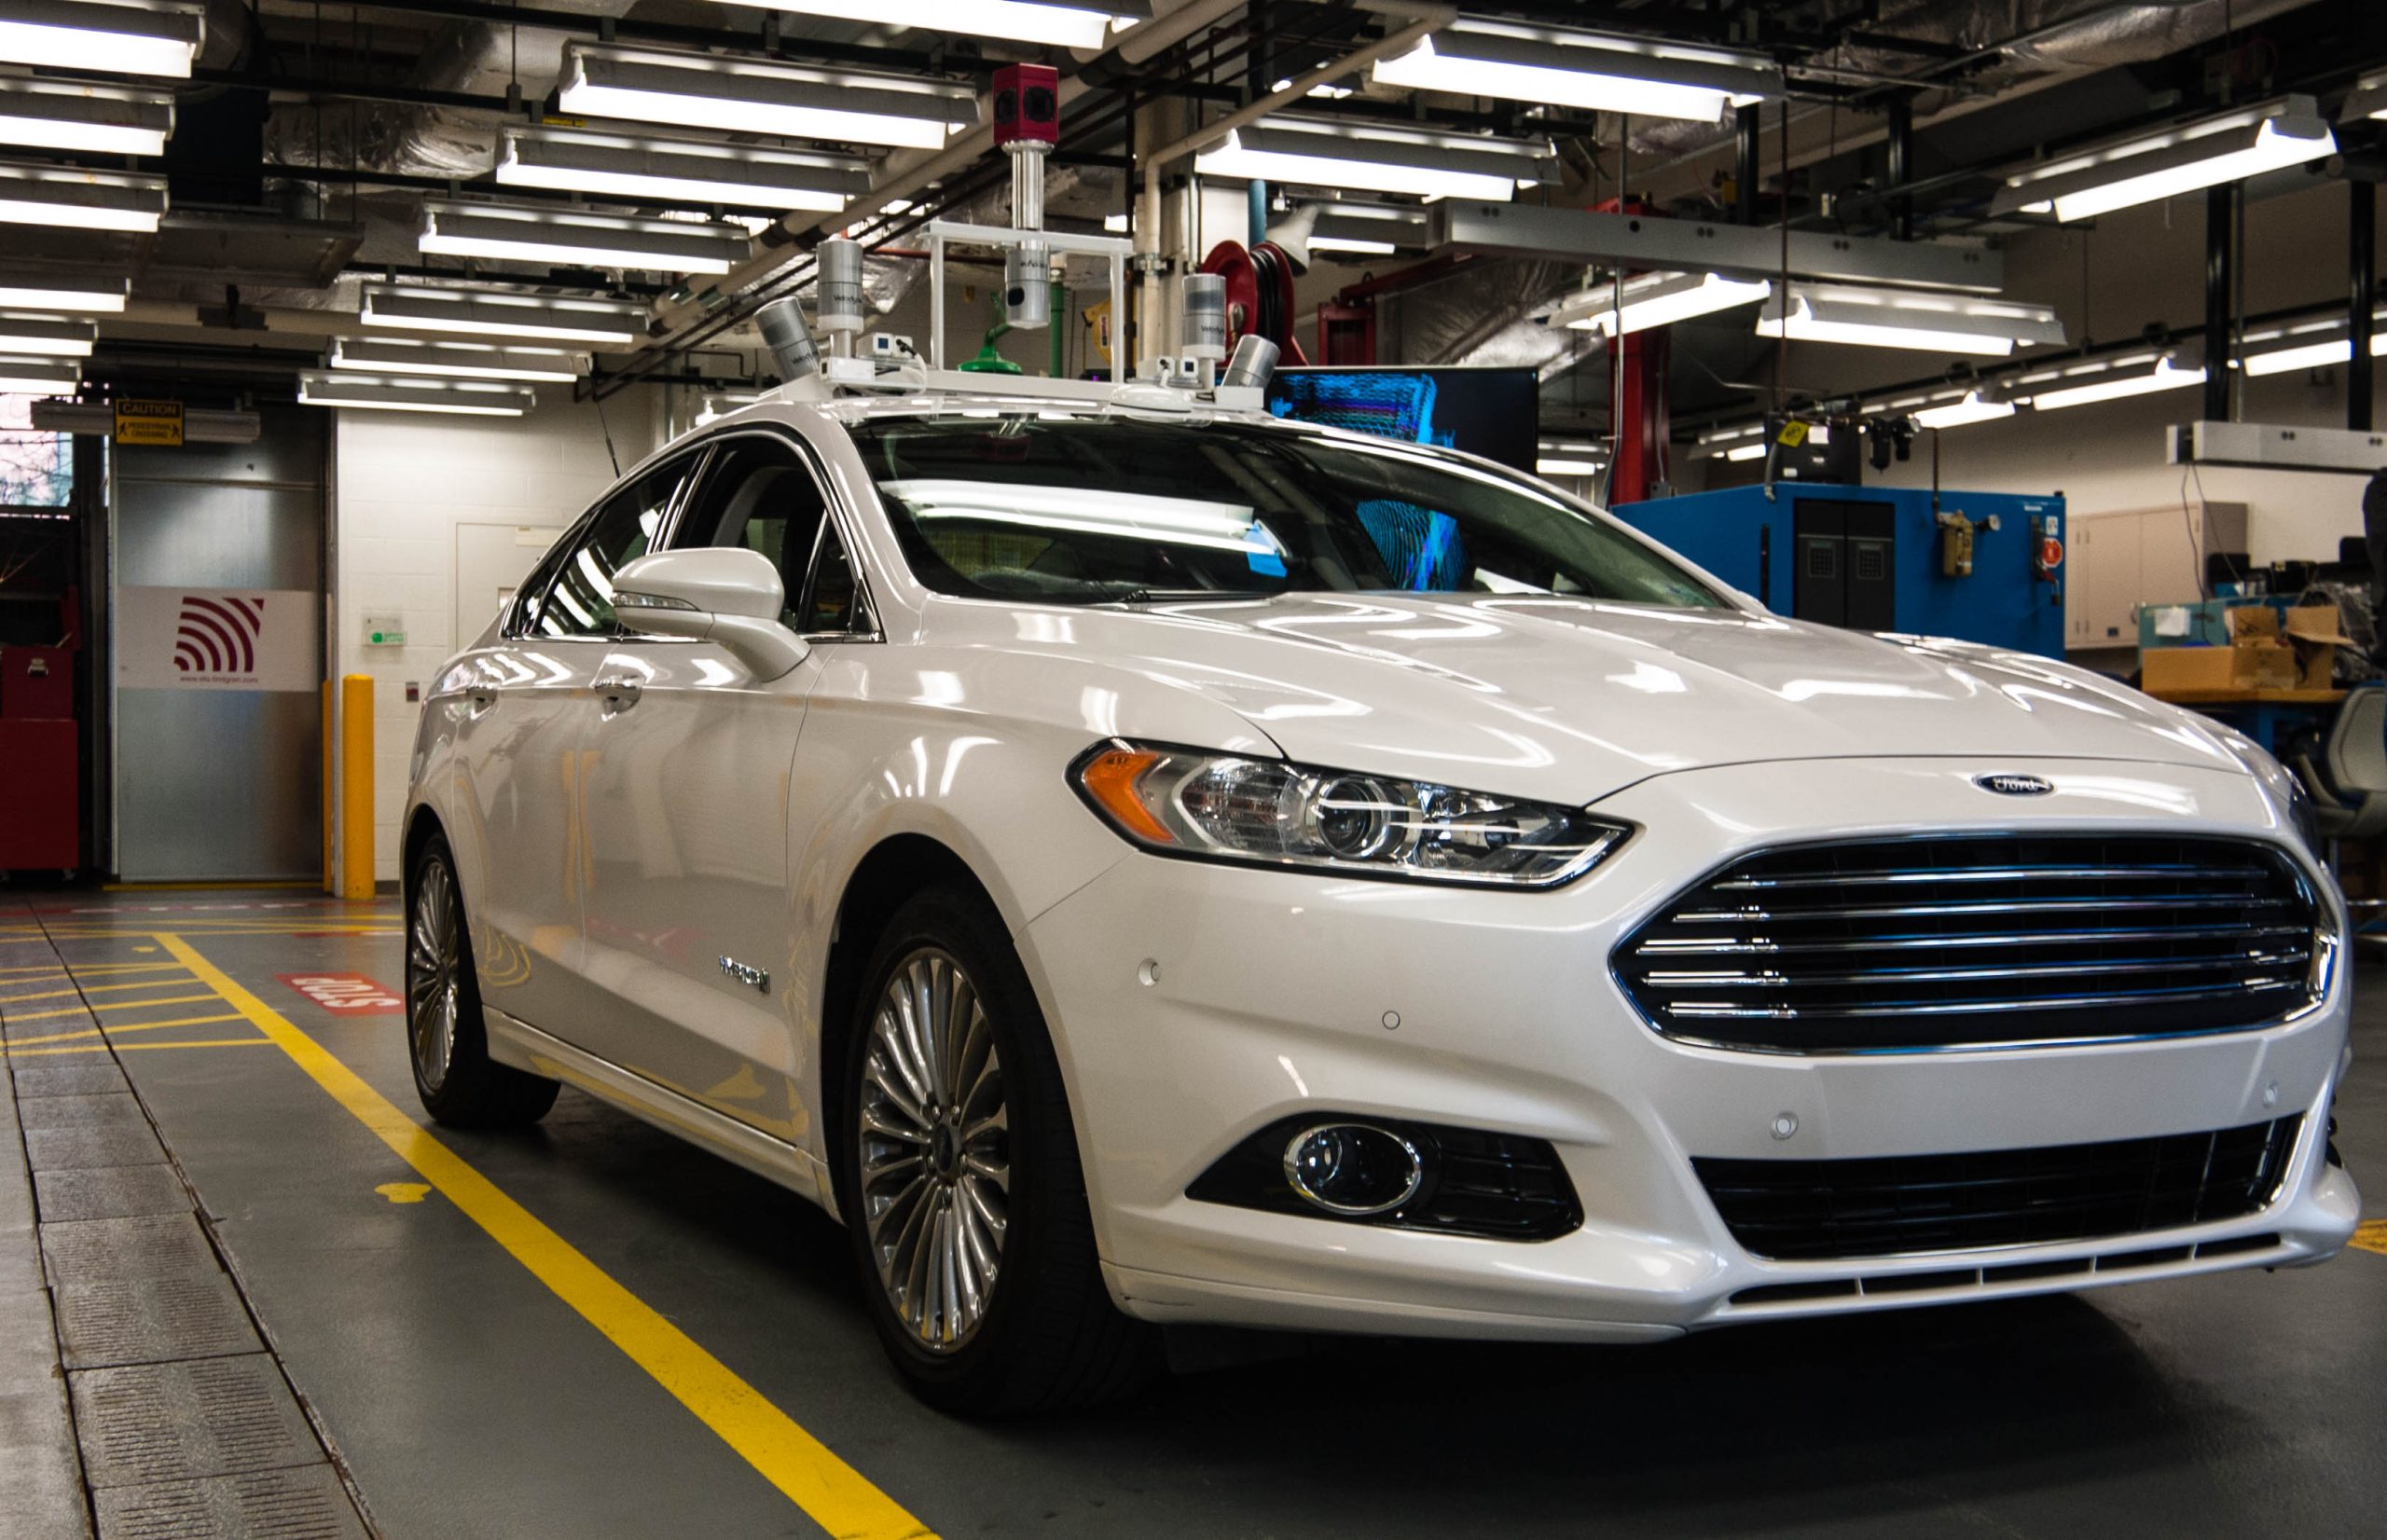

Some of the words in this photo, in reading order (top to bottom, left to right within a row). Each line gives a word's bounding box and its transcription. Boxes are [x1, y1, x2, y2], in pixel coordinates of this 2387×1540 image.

[122, 403, 177, 416] CAUTION
[1992, 777, 2050, 792] Ford
[291, 977, 402, 1008] STOP
